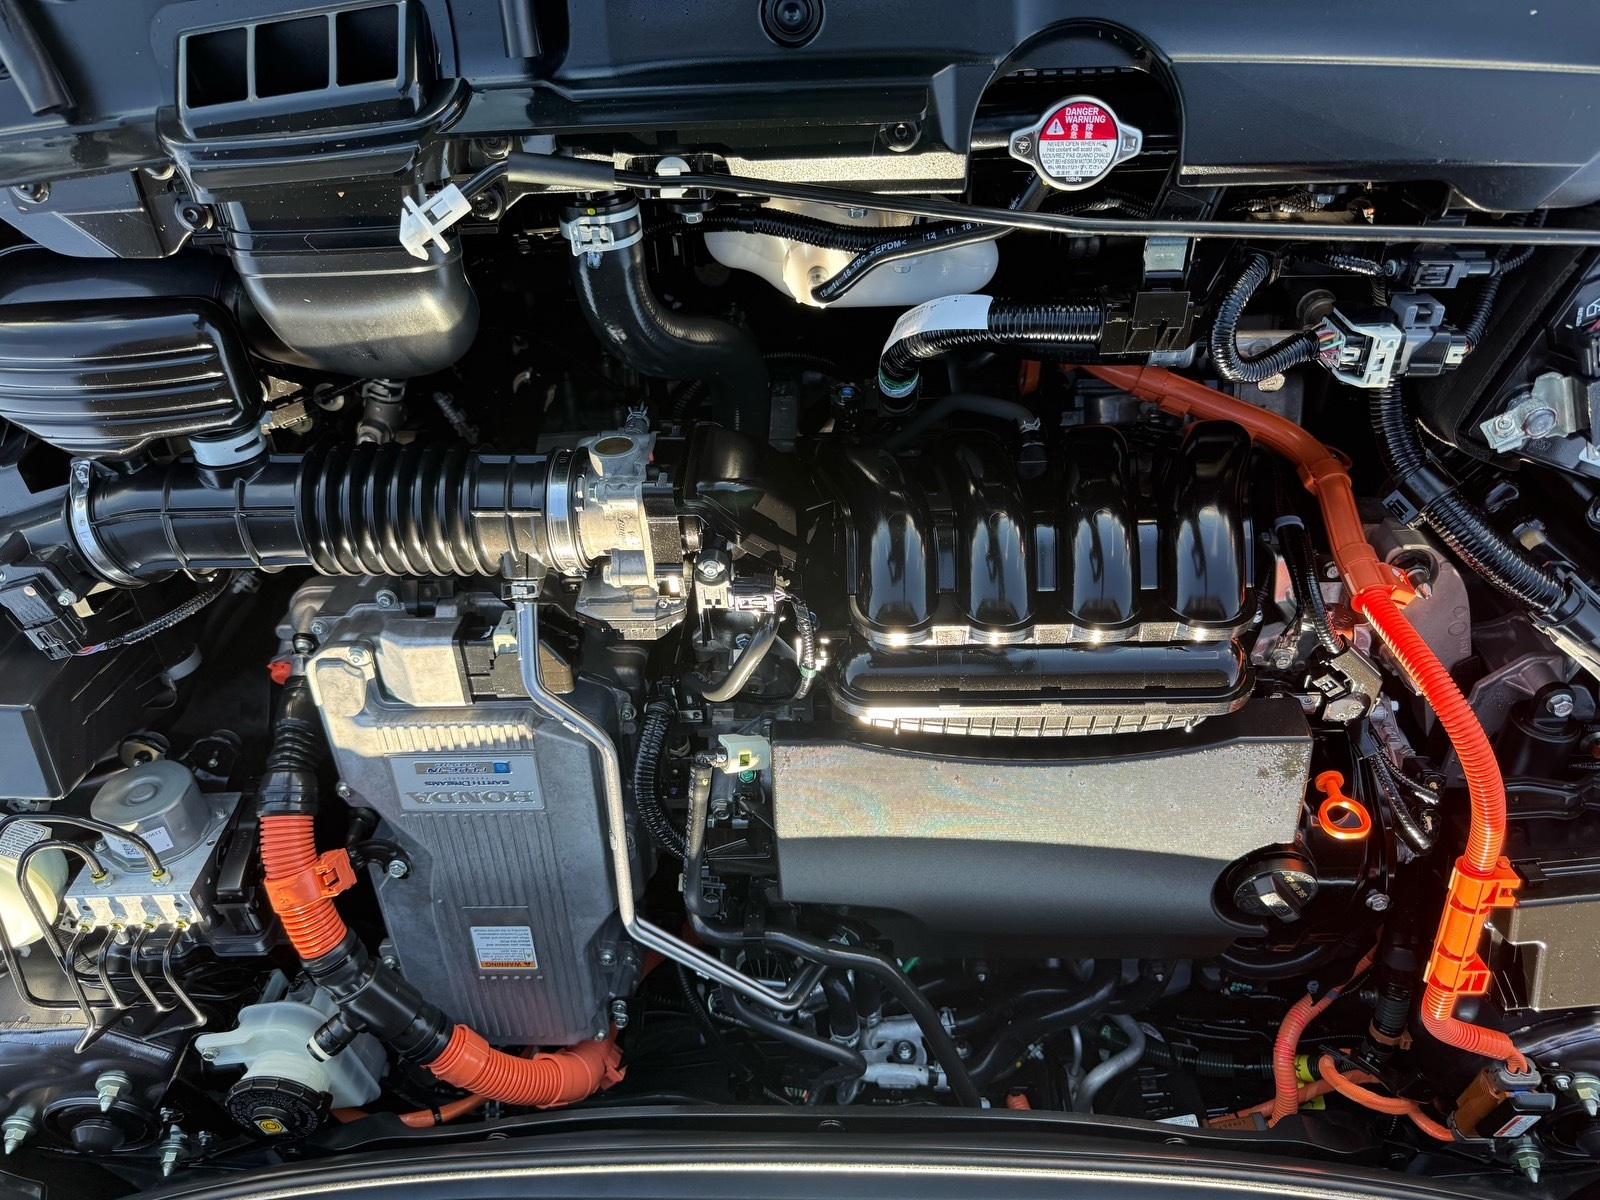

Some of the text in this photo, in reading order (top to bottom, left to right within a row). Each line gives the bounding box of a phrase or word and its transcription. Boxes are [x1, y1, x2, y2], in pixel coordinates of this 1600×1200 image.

[1066, 107, 1099, 116] DANGER
[1065, 115, 1106, 124] WARNUNG
[961, 222, 972, 232] 18
[843, 270, 852, 280] 18
[852, 254, 867, 270] TPC
[405, 790, 536, 804] HONDA
